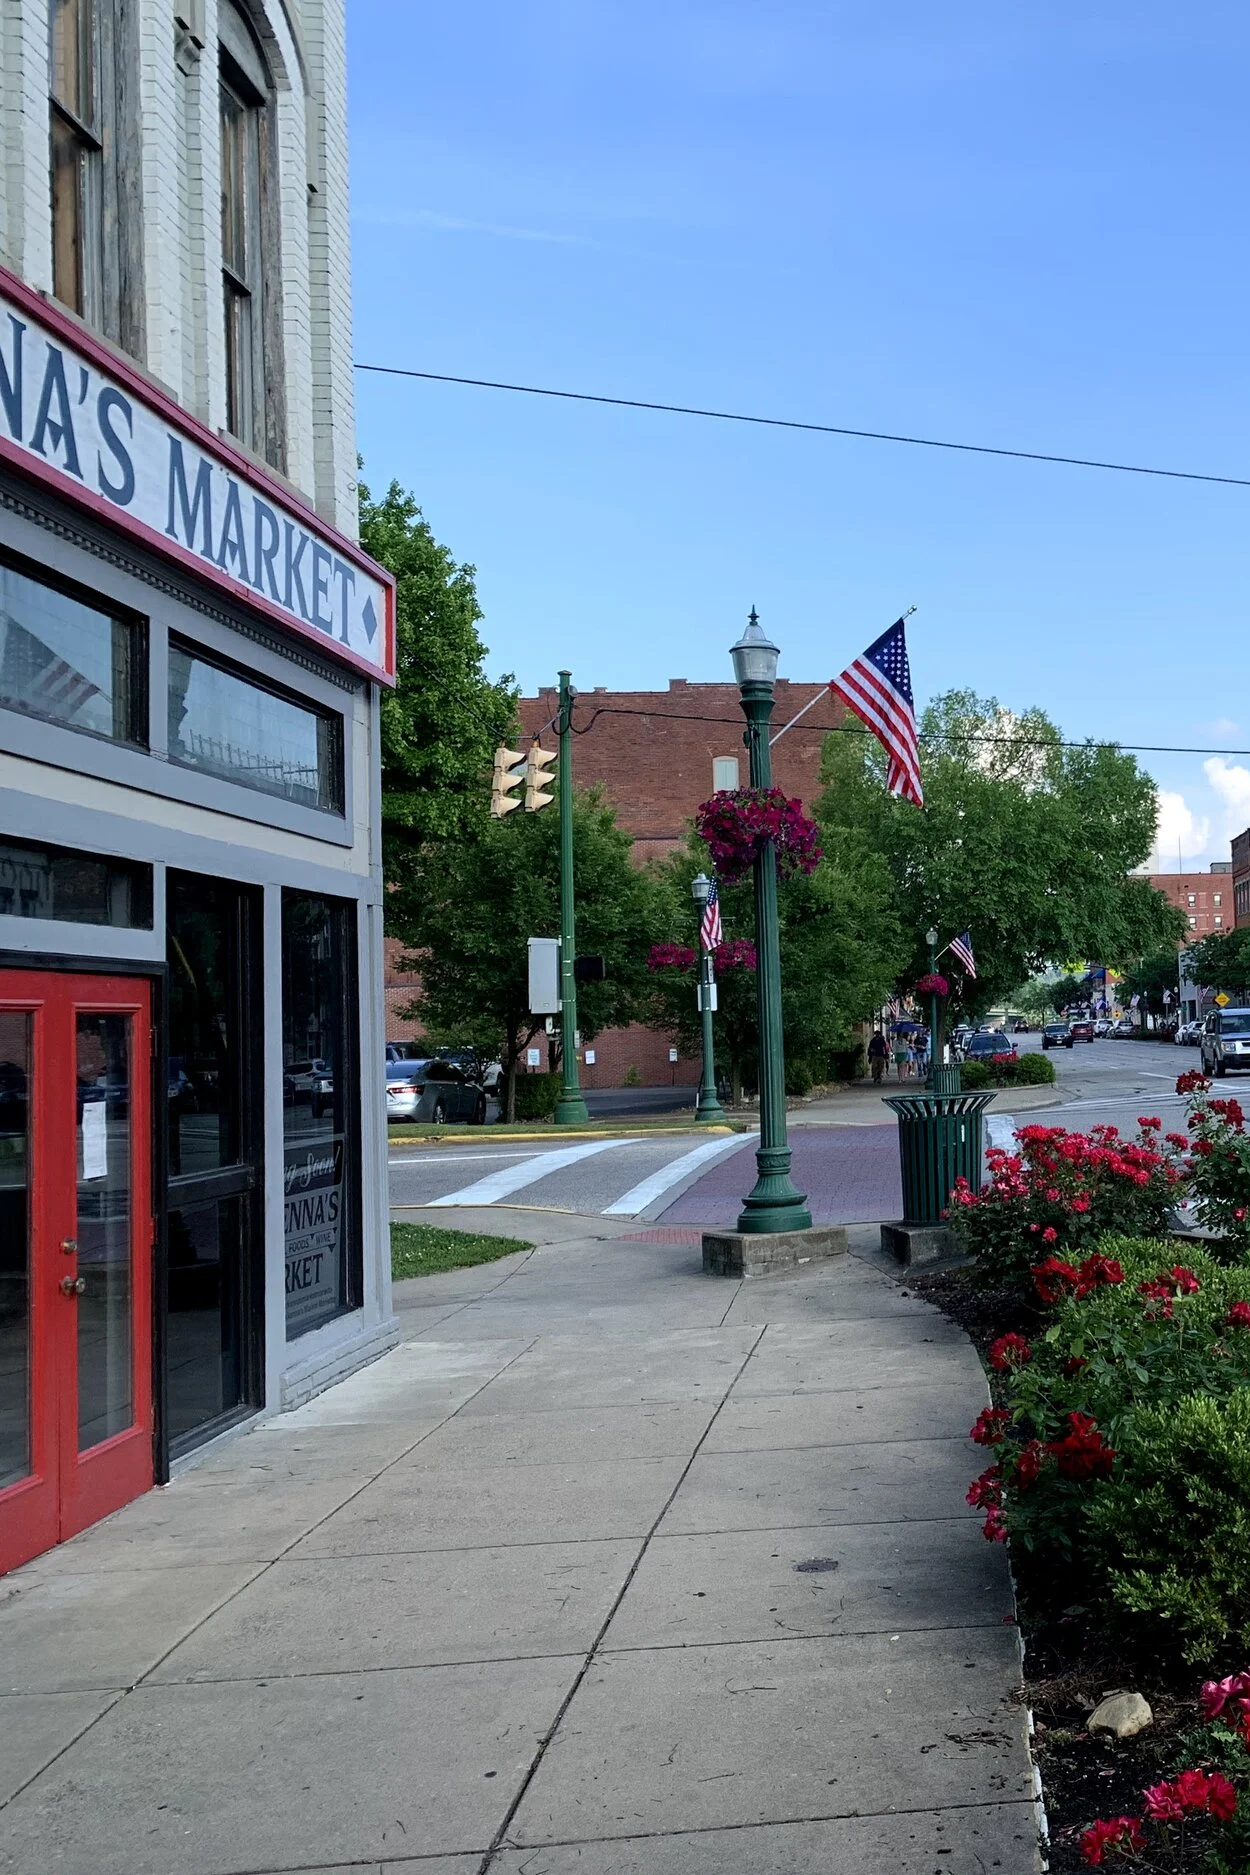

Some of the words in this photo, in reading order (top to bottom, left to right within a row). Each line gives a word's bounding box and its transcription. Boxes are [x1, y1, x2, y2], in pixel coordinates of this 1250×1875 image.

[165, 432, 355, 646] MARKET
[288, 1238, 309, 1253] FOODS
[316, 1231, 331, 1246] WINE
